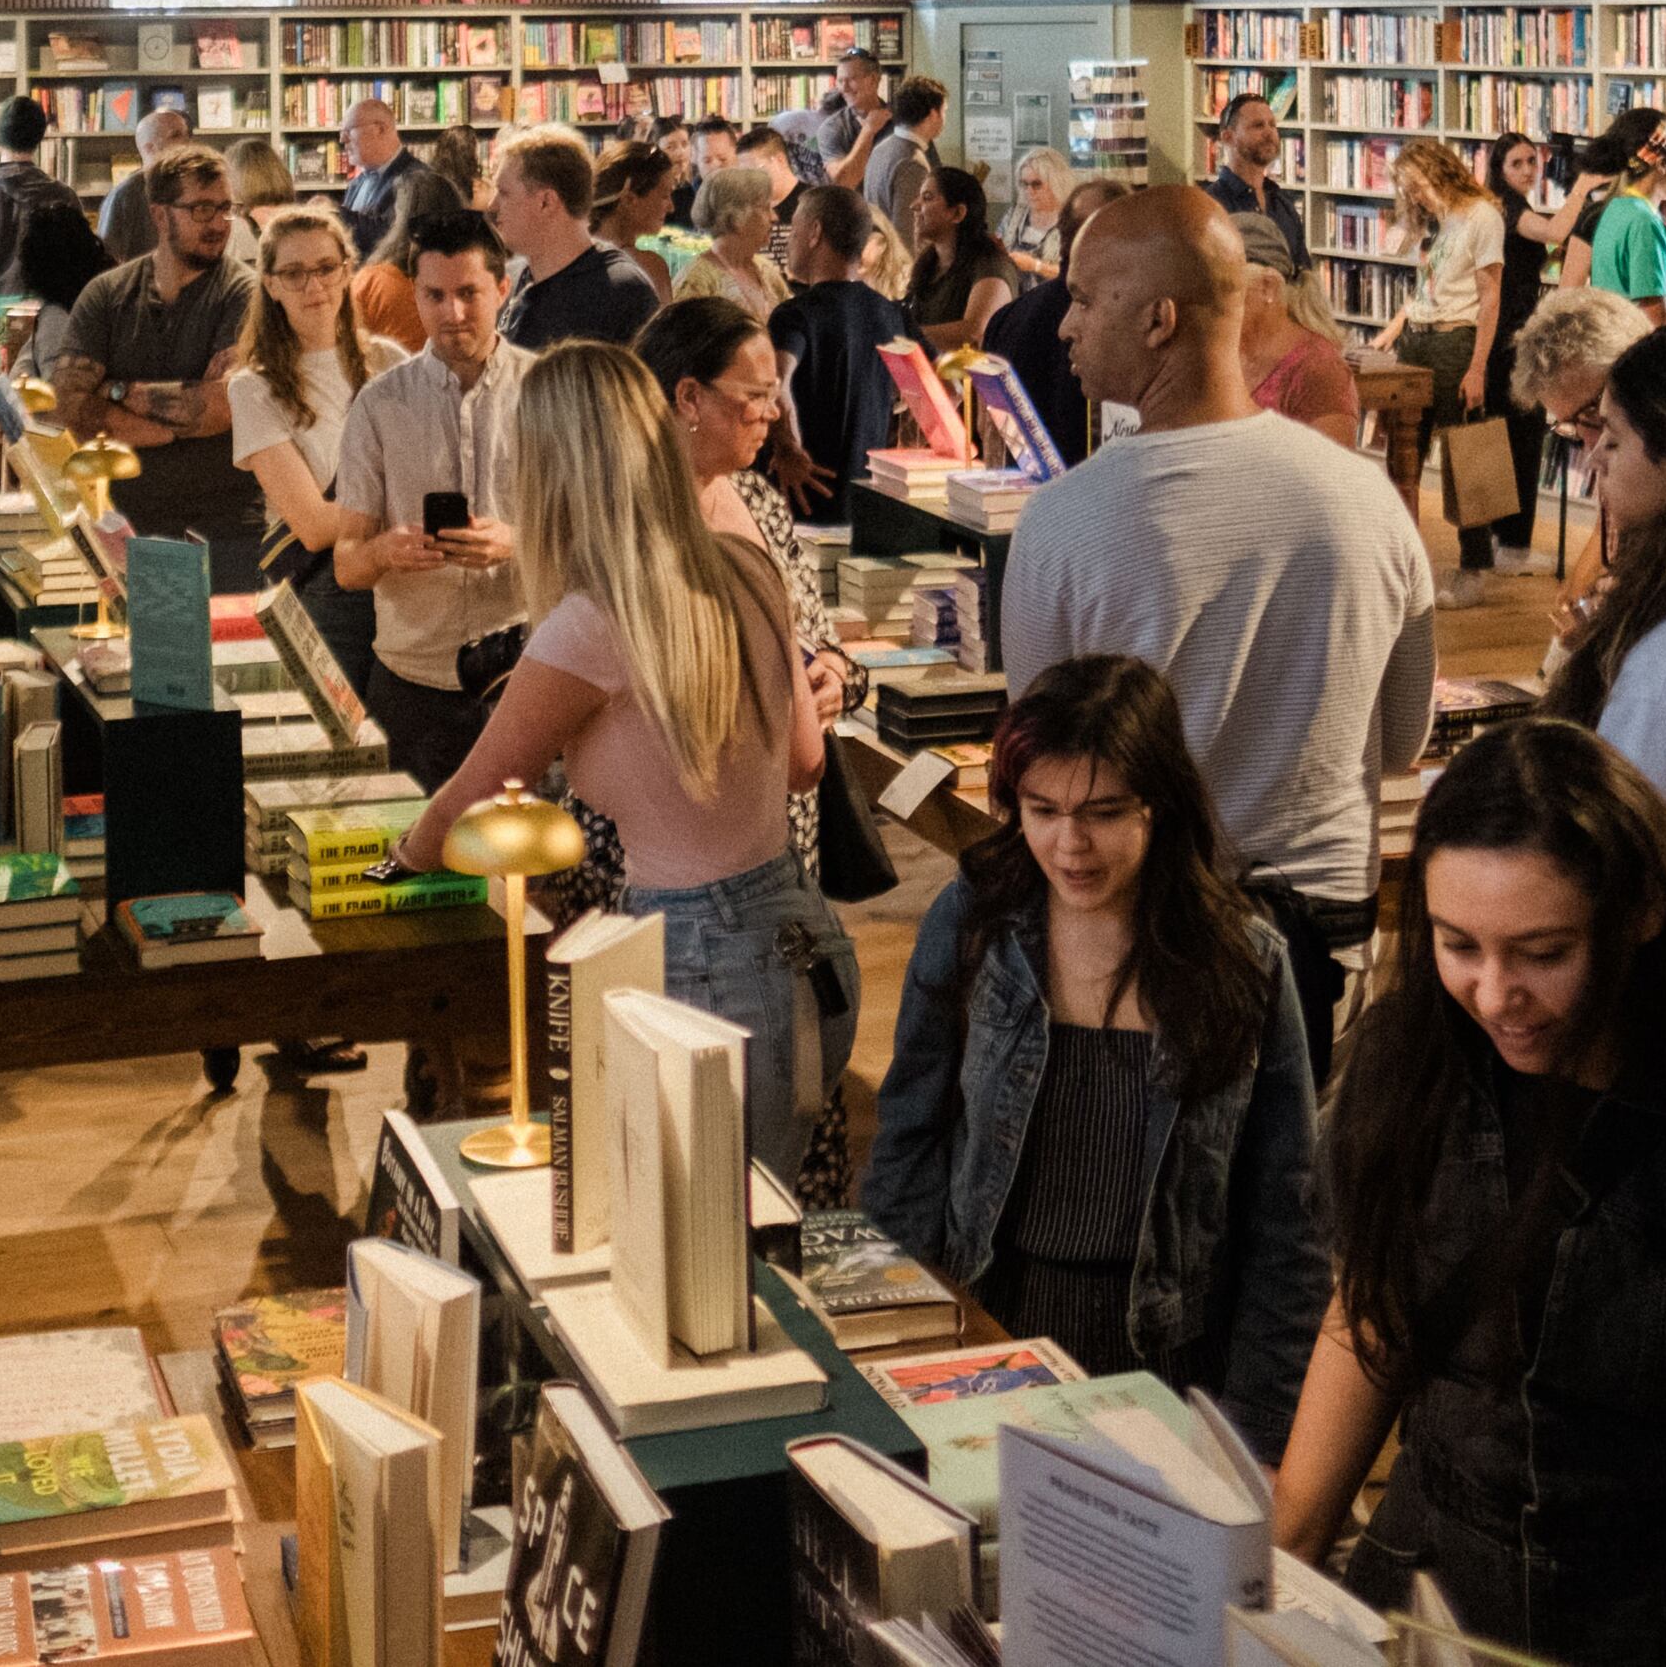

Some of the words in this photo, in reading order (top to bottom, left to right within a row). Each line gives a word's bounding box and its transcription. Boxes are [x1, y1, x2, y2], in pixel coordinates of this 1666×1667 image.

[319, 847, 341, 860] THE
[342, 842, 381, 858] FRAUD
[321, 875, 342, 888] THE
[322, 902, 342, 914] THE
[345, 898, 382, 913] FRAUD
[547, 970, 571, 1054] KNIFE
[551, 1095, 568, 1166] SALMAN
[553, 1168, 570, 1242] RUSHDIE
[22, 1439, 60, 1497] LOVED
[68, 1452, 96, 1479] WE
[102, 1427, 159, 1494] MILLET
[149, 1423, 203, 1482] LYDIA
[139, 1590, 175, 1629] STORY
